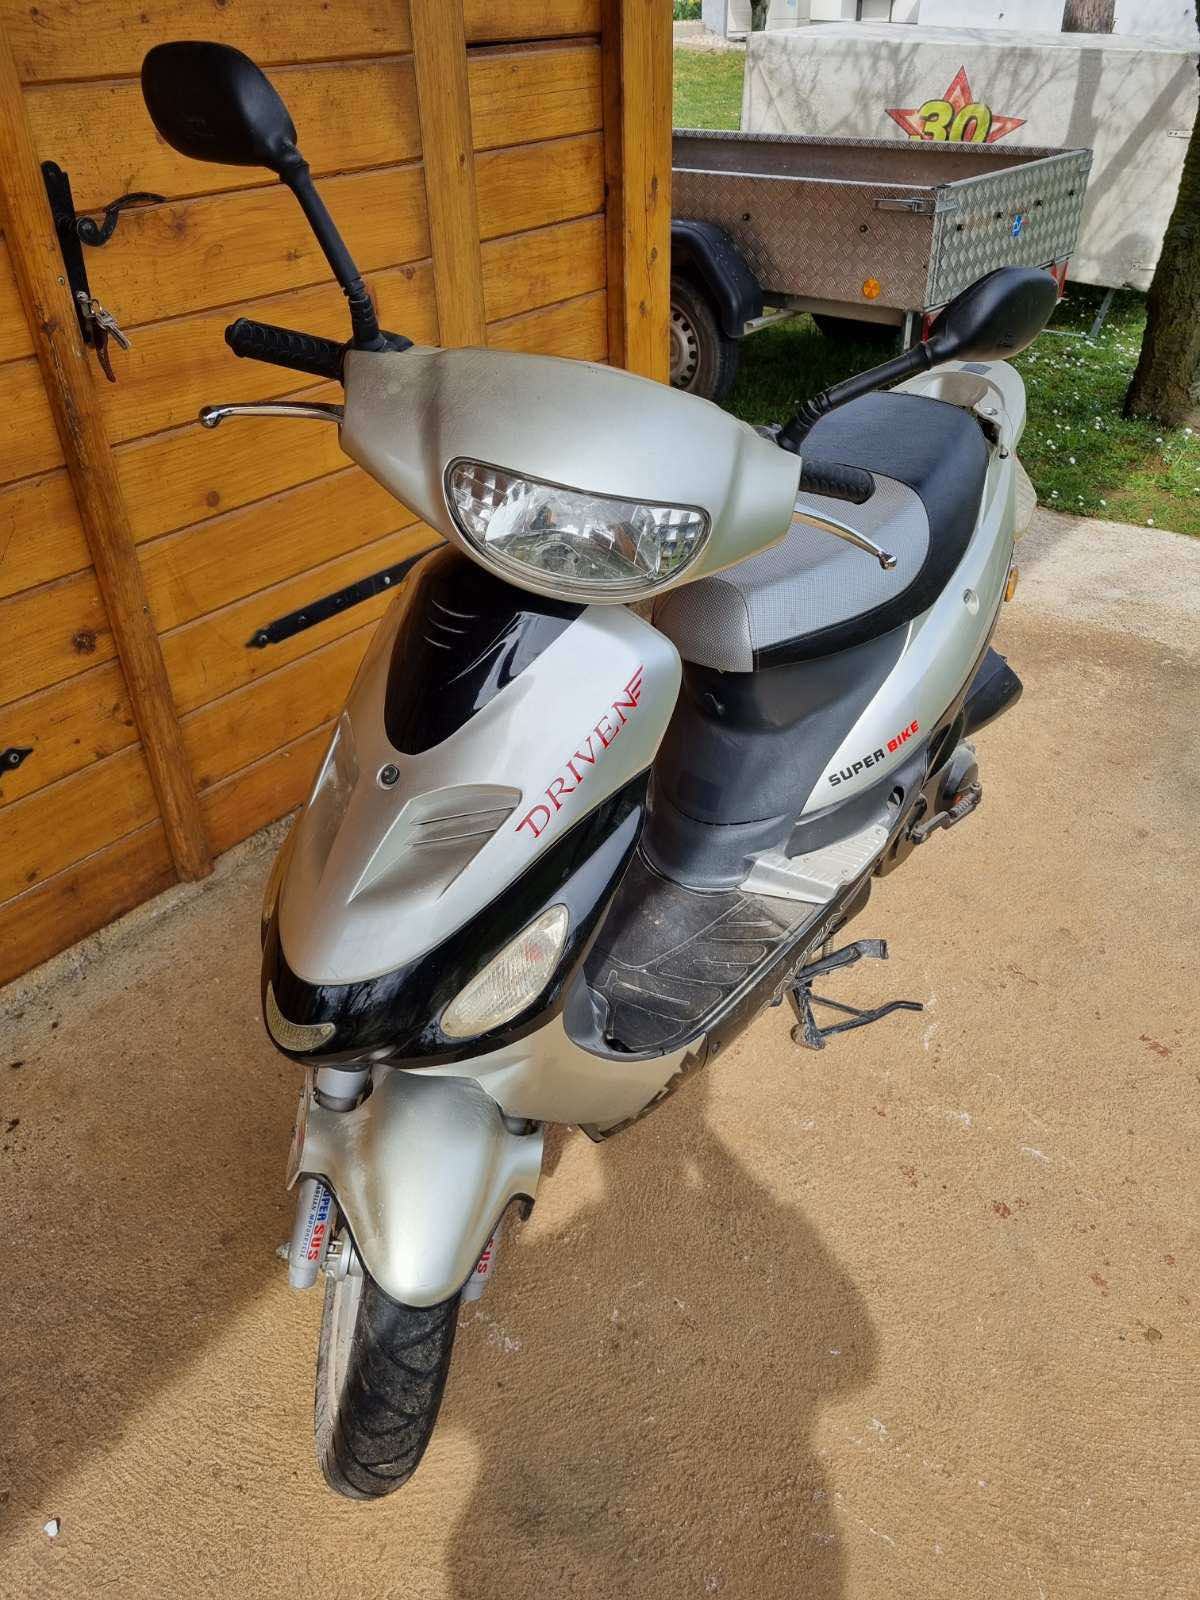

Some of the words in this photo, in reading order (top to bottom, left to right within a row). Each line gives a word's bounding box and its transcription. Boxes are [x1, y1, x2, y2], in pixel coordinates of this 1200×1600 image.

[909, 99, 992, 143] 30
[515, 664, 644, 838] DRIVEN
[828, 748, 885, 787] SUPER
[886, 720, 920, 753] BIKE
[317, 1190, 331, 1221] UPER
[308, 1222, 326, 1261] SUS
